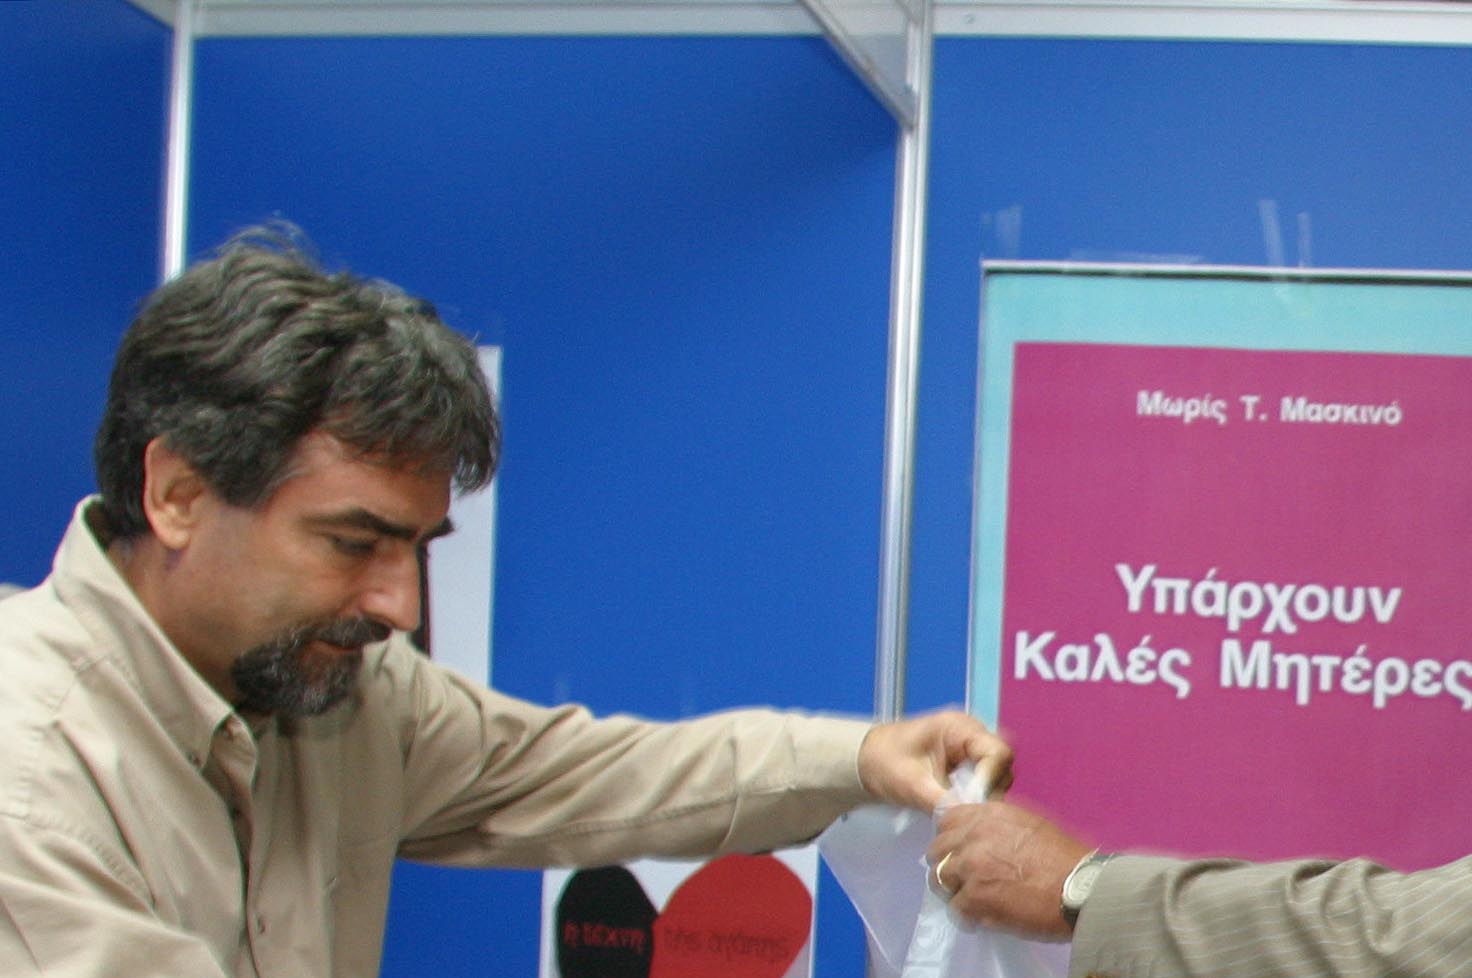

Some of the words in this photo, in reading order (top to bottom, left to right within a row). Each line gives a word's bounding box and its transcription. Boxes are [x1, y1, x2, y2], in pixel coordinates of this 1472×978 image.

[1136, 390, 1227, 425] Μωρίς
[1241, 395, 1269, 422] Τ.
[1280, 396, 1403, 426] Μασκινό
[1116, 563, 1401, 634] Υπάρχουν
[1013, 631, 1191, 698] Καλές
